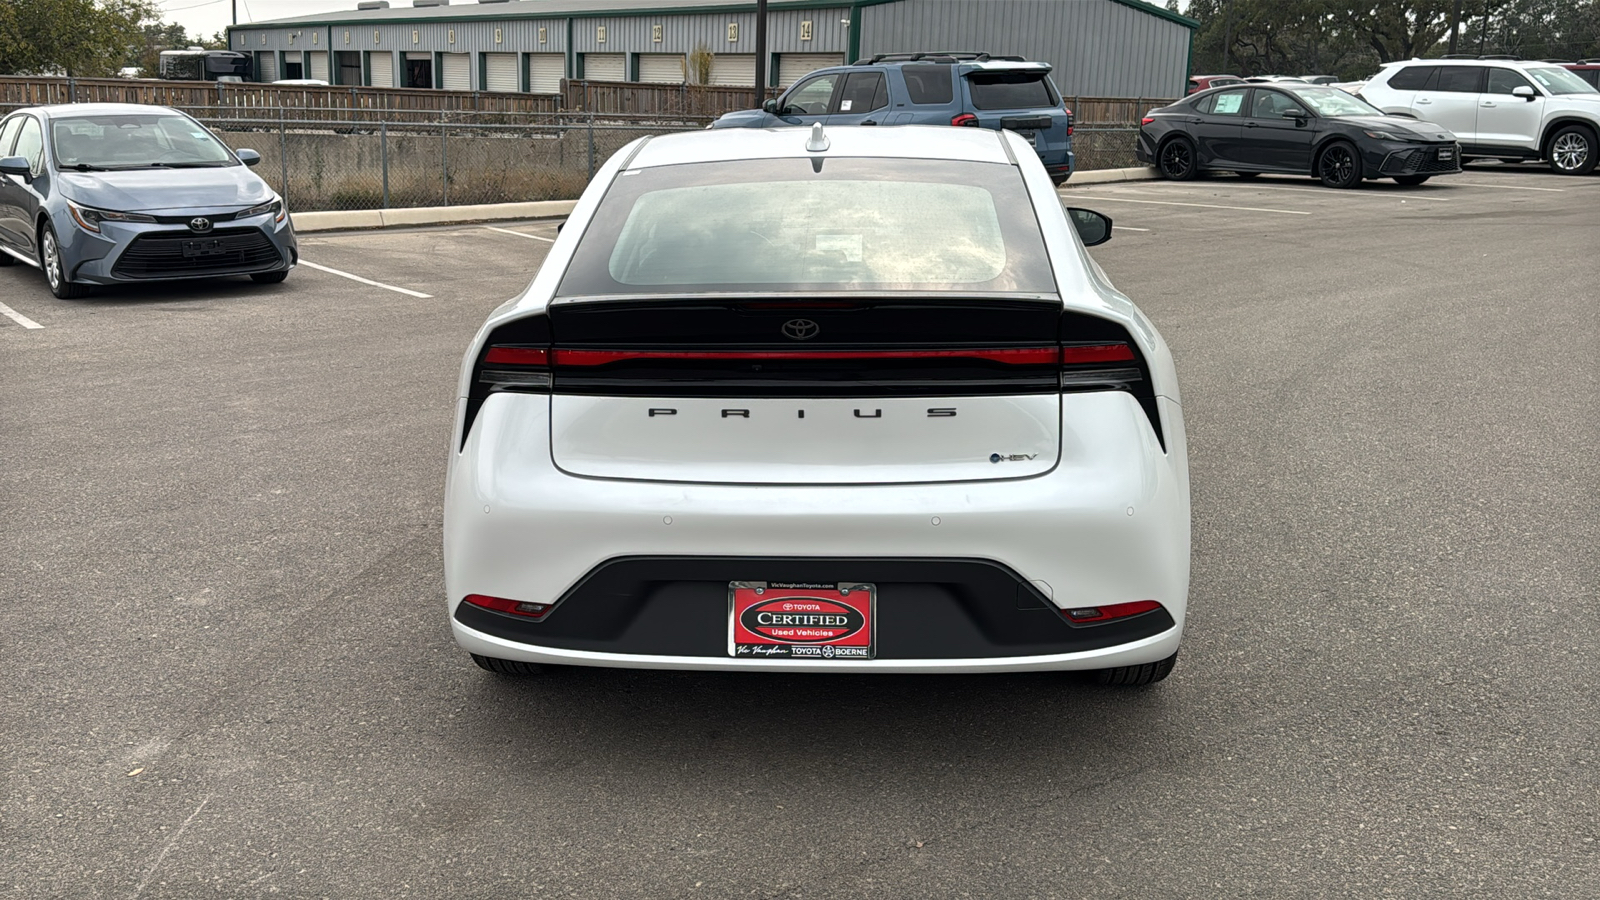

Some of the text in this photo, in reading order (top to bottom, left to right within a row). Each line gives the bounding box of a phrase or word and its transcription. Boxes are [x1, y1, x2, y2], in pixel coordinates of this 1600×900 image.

[728, 25, 737, 40] 13
[801, 23, 811, 38] 14
[648, 407, 957, 419] PRIUS
[1000, 453, 1038, 462] HEV
[757, 612, 848, 626] CERTIFIED
[796, 629, 833, 637] Vehicles
[752, 645, 789, 656] Vaughan
[791, 647, 822, 655] TOYOTA
[836, 647, 868, 656] BOERNE
